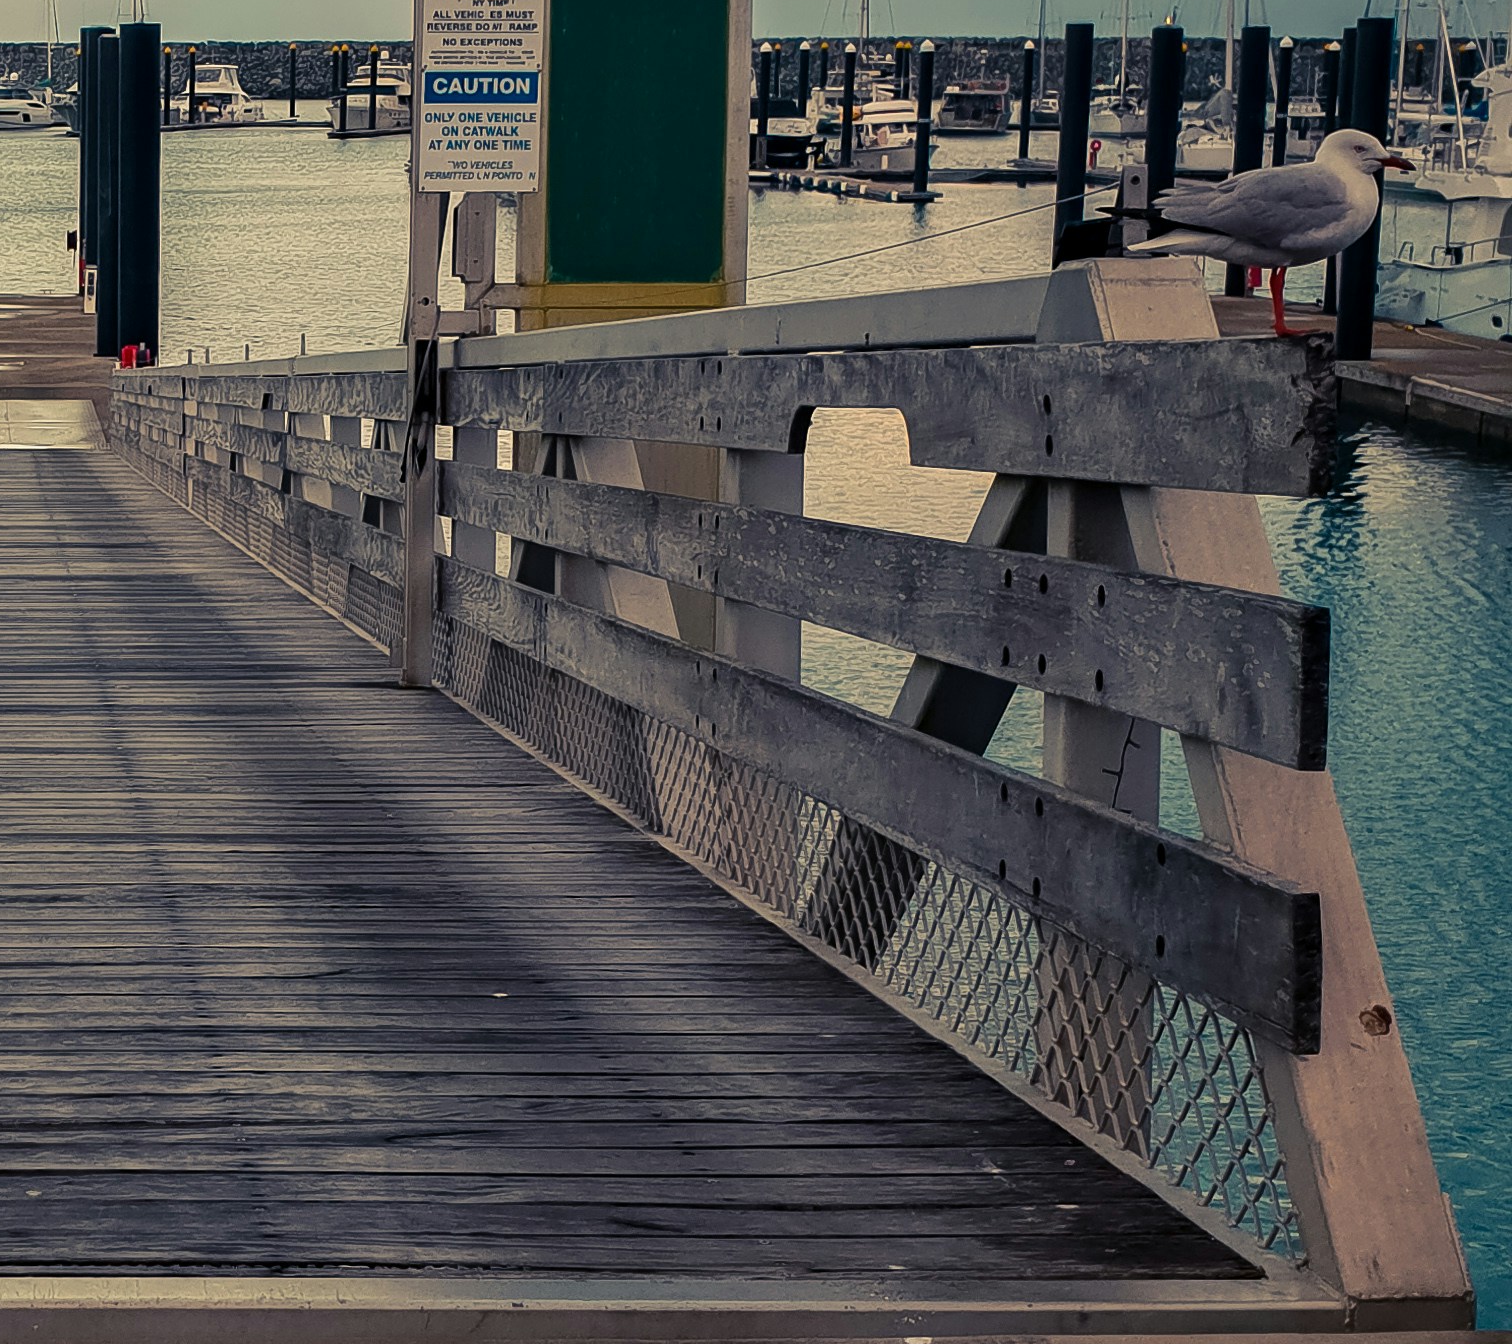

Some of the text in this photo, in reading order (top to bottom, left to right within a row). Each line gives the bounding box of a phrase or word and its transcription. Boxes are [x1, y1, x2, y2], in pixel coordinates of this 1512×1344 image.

[433, 10, 534, 18] ALL VEHICES MUST
[427, 23, 472, 31] REVERSE
[509, 23, 537, 31] RAMP
[442, 38, 523, 46] NO EXCEPTIONS
[432, 77, 530, 94] CAUTION
[424, 112, 537, 123] ONLY ONE VEHICLE
[441, 126, 519, 136] ON CATWALK
[428, 140, 531, 150] AT ANY ONE TIME
[470, 161, 513, 169] VEHICLES
[424, 171, 475, 180] PERMITTED
[491, 171, 536, 180] PONTON
